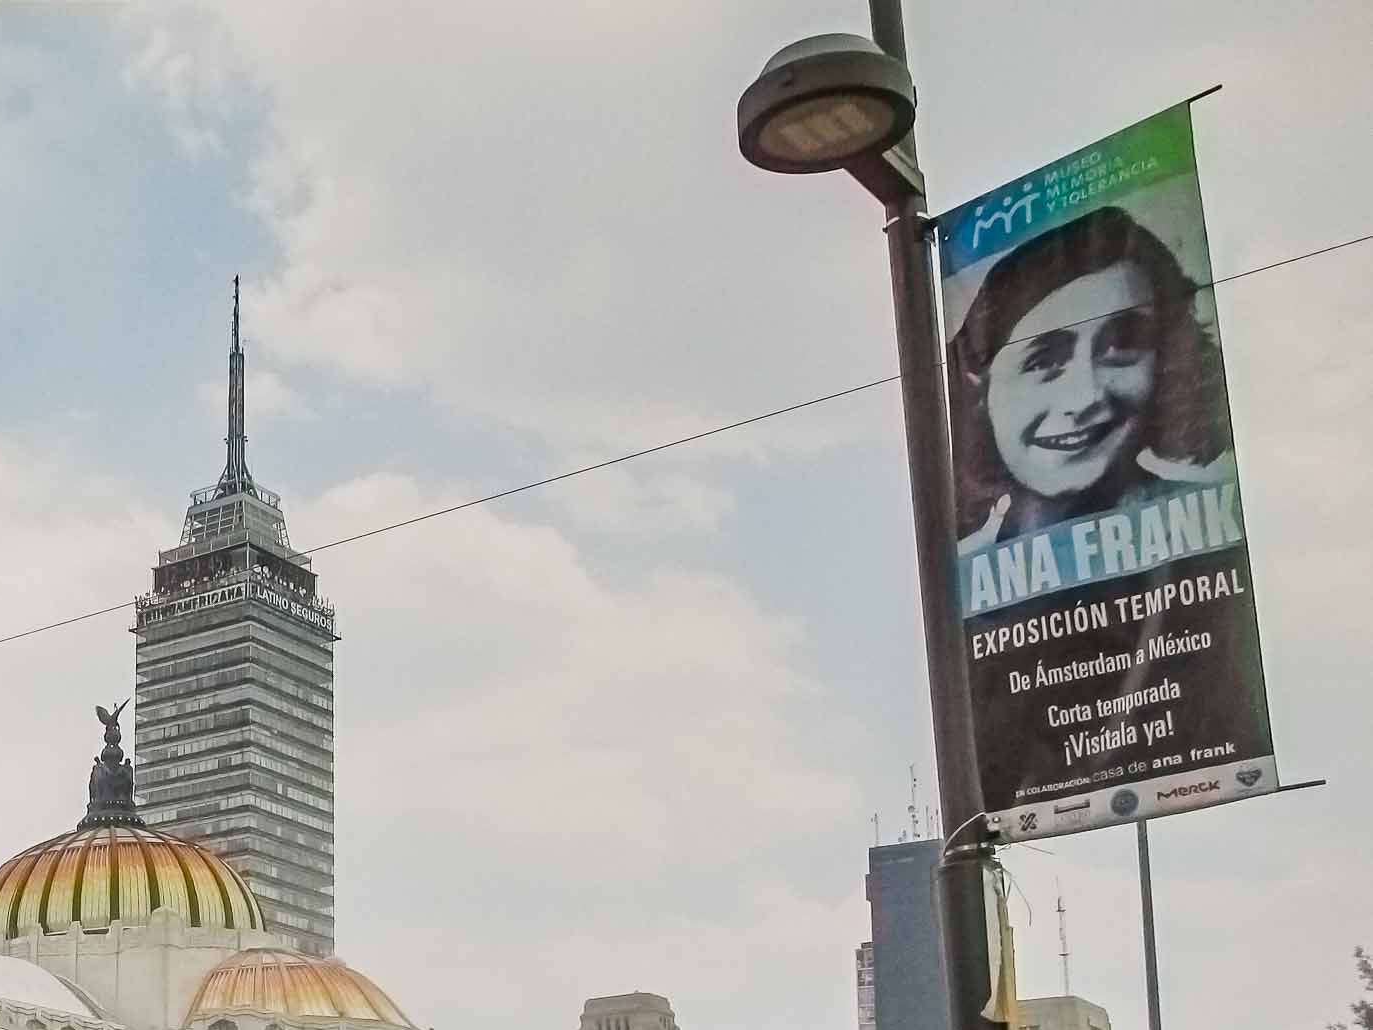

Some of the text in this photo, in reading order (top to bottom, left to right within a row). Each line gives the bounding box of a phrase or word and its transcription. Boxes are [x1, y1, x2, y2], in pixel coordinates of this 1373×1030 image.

[1044, 151, 1102, 187] MUSEO
[1046, 156, 1124, 200] MEMORIA
[1060, 157, 1159, 209] TOLERANCIA
[970, 484, 1243, 611] ANA FRANK
[257, 585, 333, 631] LATINO SEGUROS
[972, 569, 1244, 660] EXPOSICIÓN TEMPORAL
[1009, 629, 1211, 694] De Ámsterdam a México
[1048, 678, 1181, 727] Corta temporada
[1064, 711, 1174, 766] ¡Visítala ya!
[1092, 742, 1236, 783] casa de ana frank
